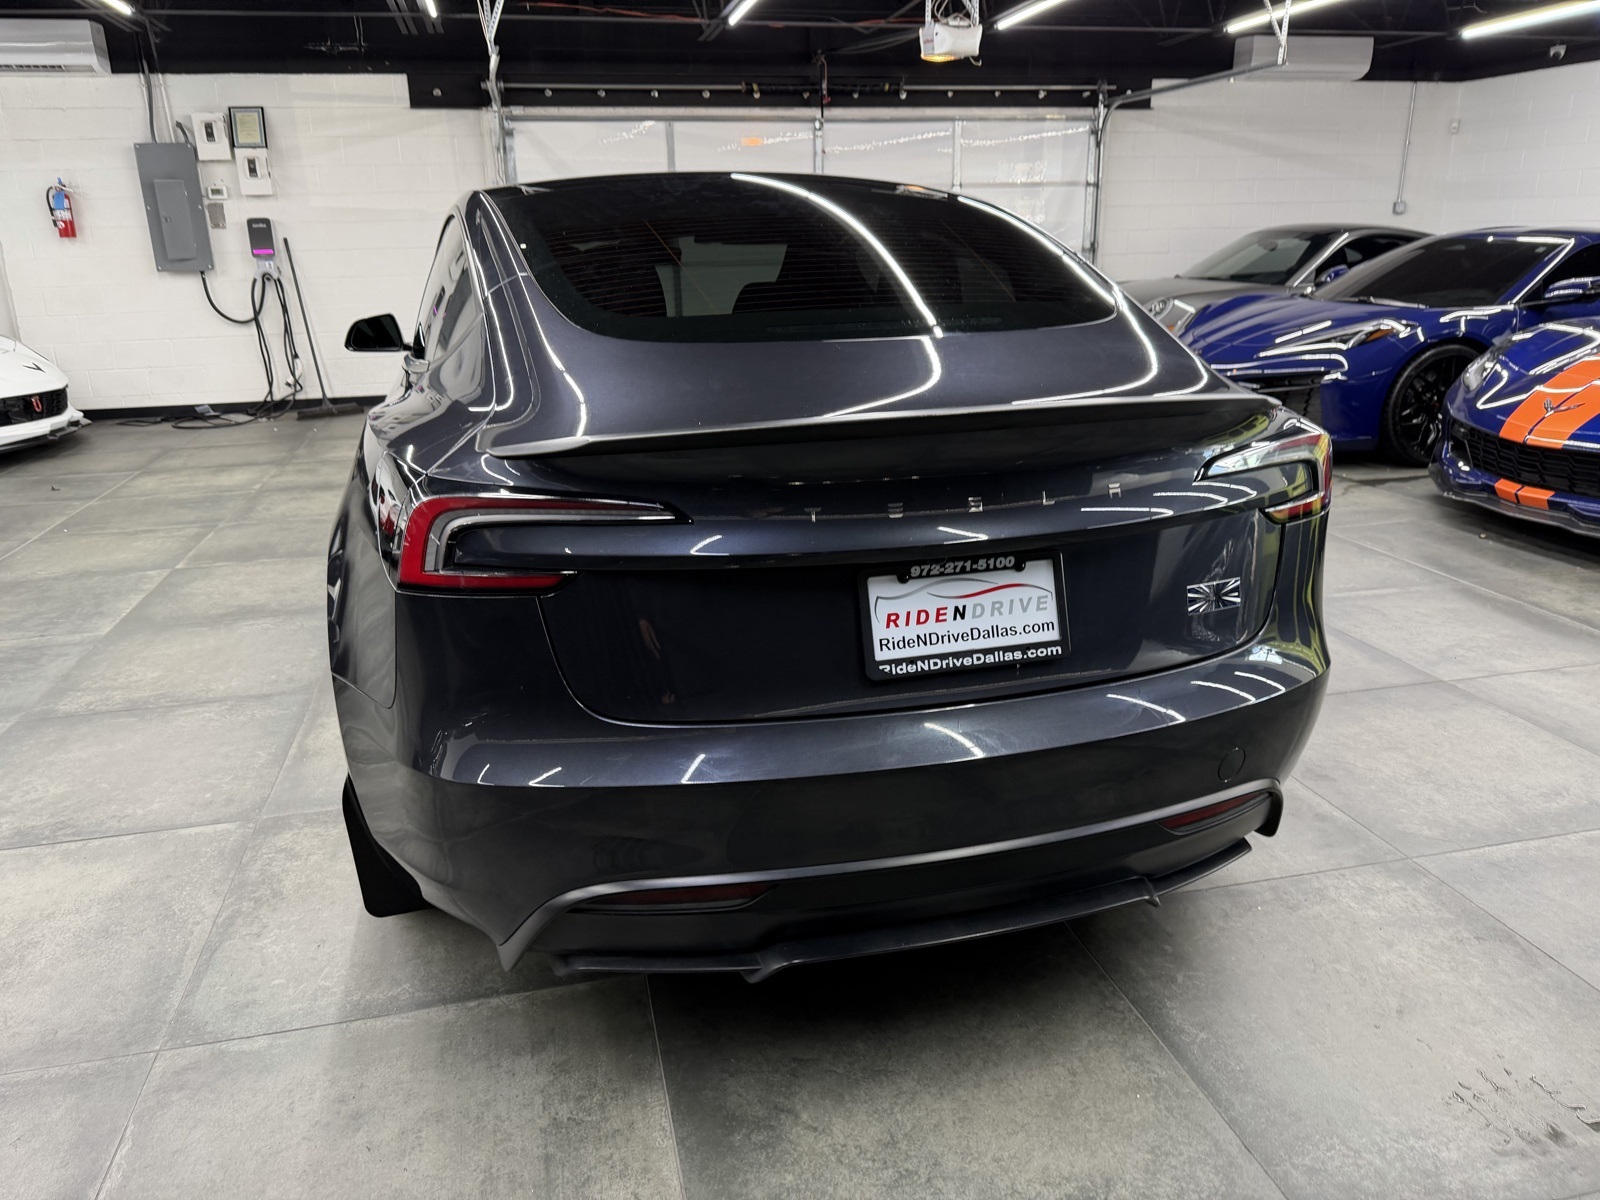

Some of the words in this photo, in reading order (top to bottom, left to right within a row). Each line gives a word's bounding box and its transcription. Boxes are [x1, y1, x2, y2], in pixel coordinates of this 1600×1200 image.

[804, 482, 1121, 522] TESLA
[910, 556, 1015, 577] 972-271-5100
[879, 621, 1055, 652] RideNDriveDallas.com
[879, 645, 1062, 675] RideNDriveDallas.com
